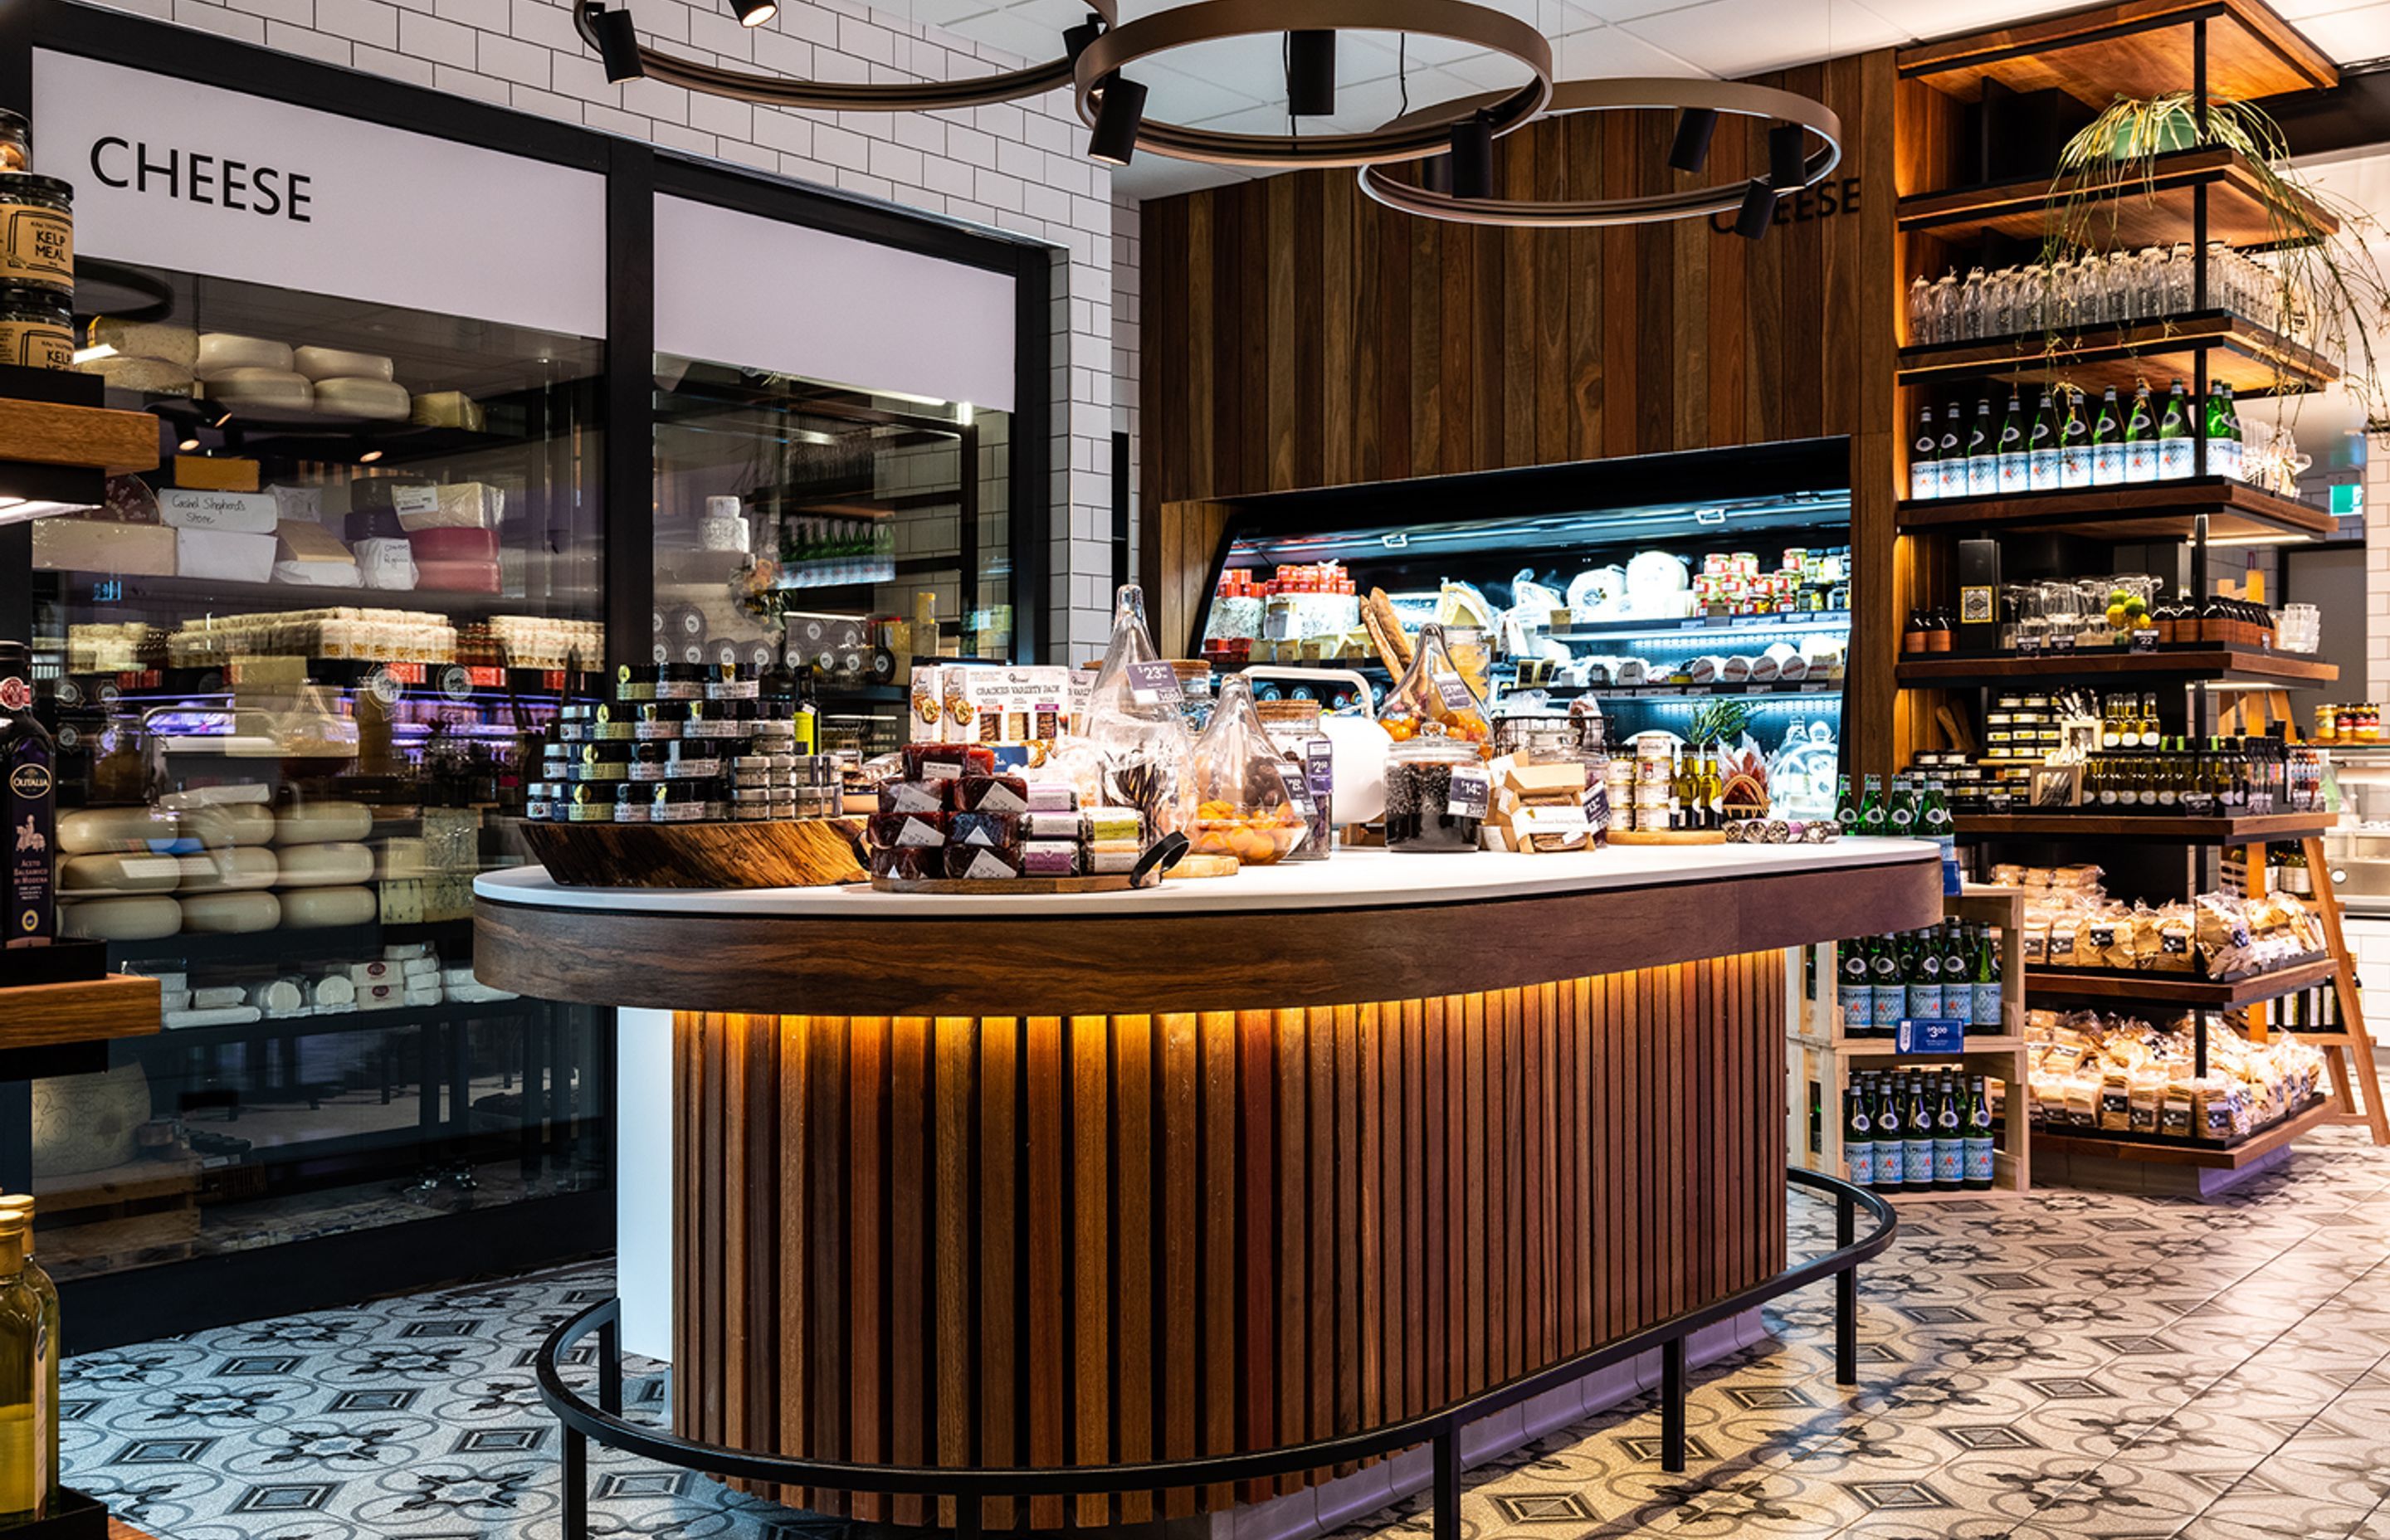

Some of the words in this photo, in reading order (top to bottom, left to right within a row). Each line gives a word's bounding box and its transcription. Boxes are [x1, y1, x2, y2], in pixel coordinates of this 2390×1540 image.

[90, 136, 310, 223] CHEESE
[1709, 178, 1861, 235] CEESE
[36, 231, 66, 246] KELP
[35, 244, 66, 262] MEAL
[13, 777, 48, 787] OLITALIA
